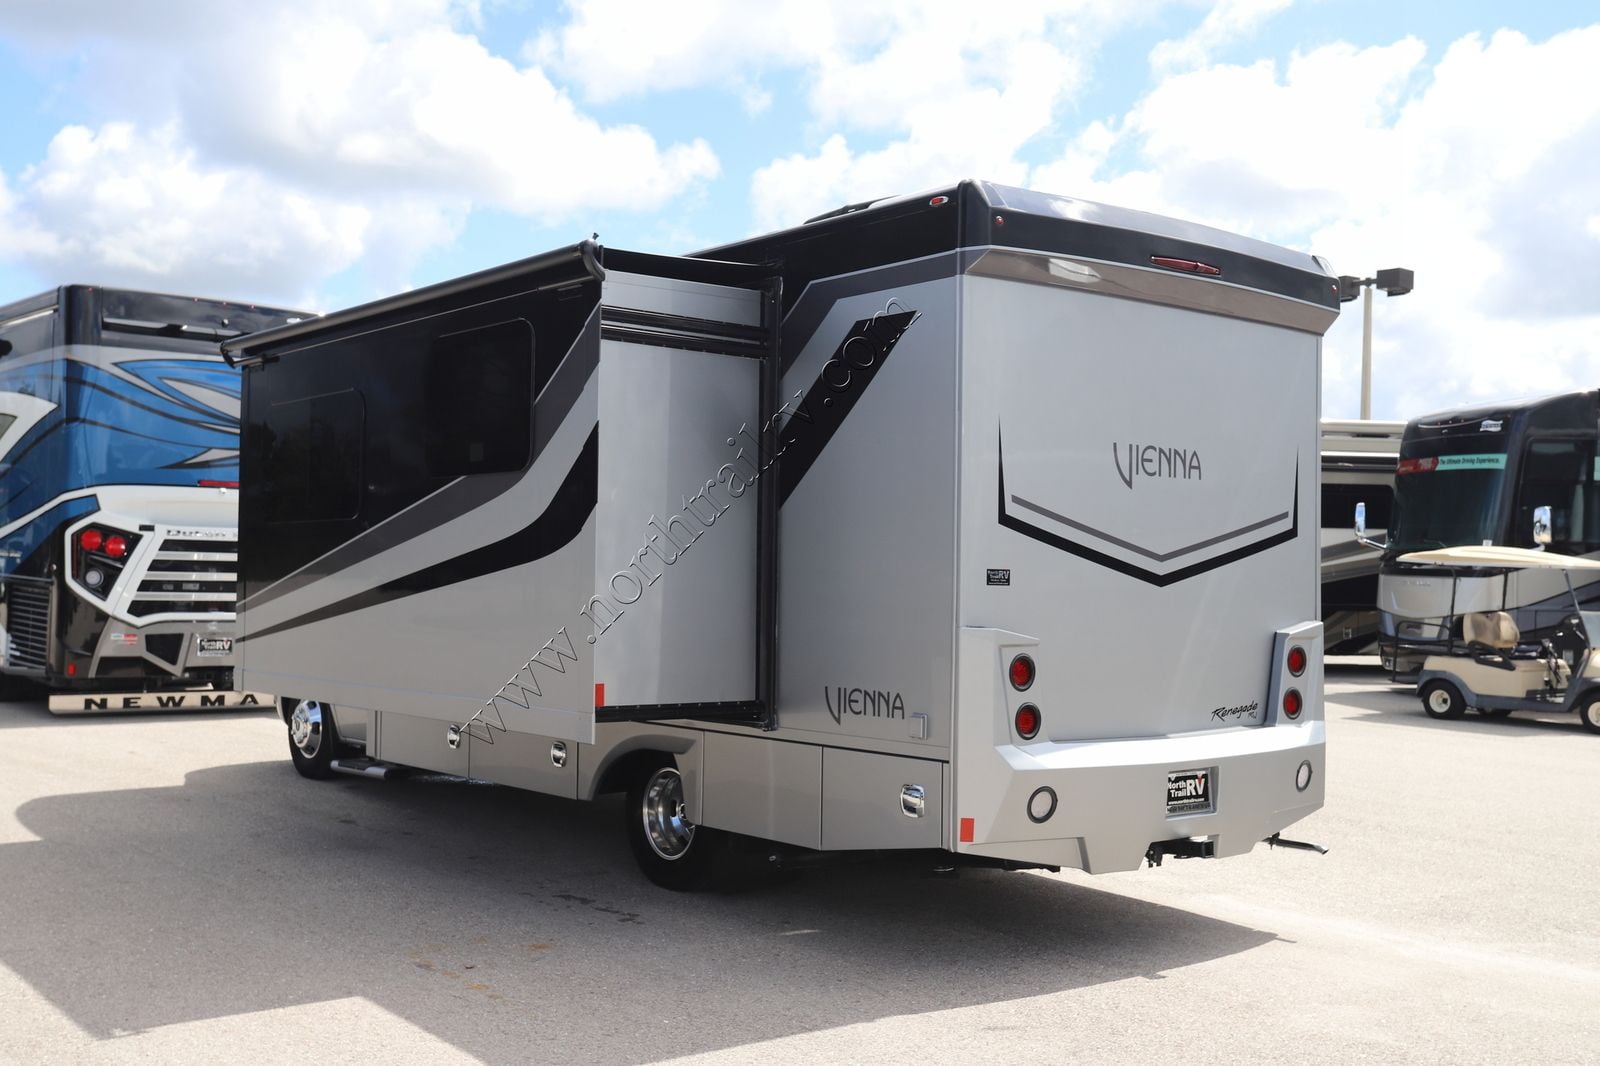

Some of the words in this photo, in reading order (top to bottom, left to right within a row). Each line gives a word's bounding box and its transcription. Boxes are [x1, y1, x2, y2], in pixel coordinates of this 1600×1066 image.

[1113, 442, 1202, 490] VIENNA
[999, 570, 1010, 579] RV
[216, 640, 231, 650] RV
[825, 686, 905, 726] VIENNA
[1211, 700, 1258, 721] Renegade
[1170, 788, 1187, 798] Trail
[1186, 777, 1205, 797] RV
